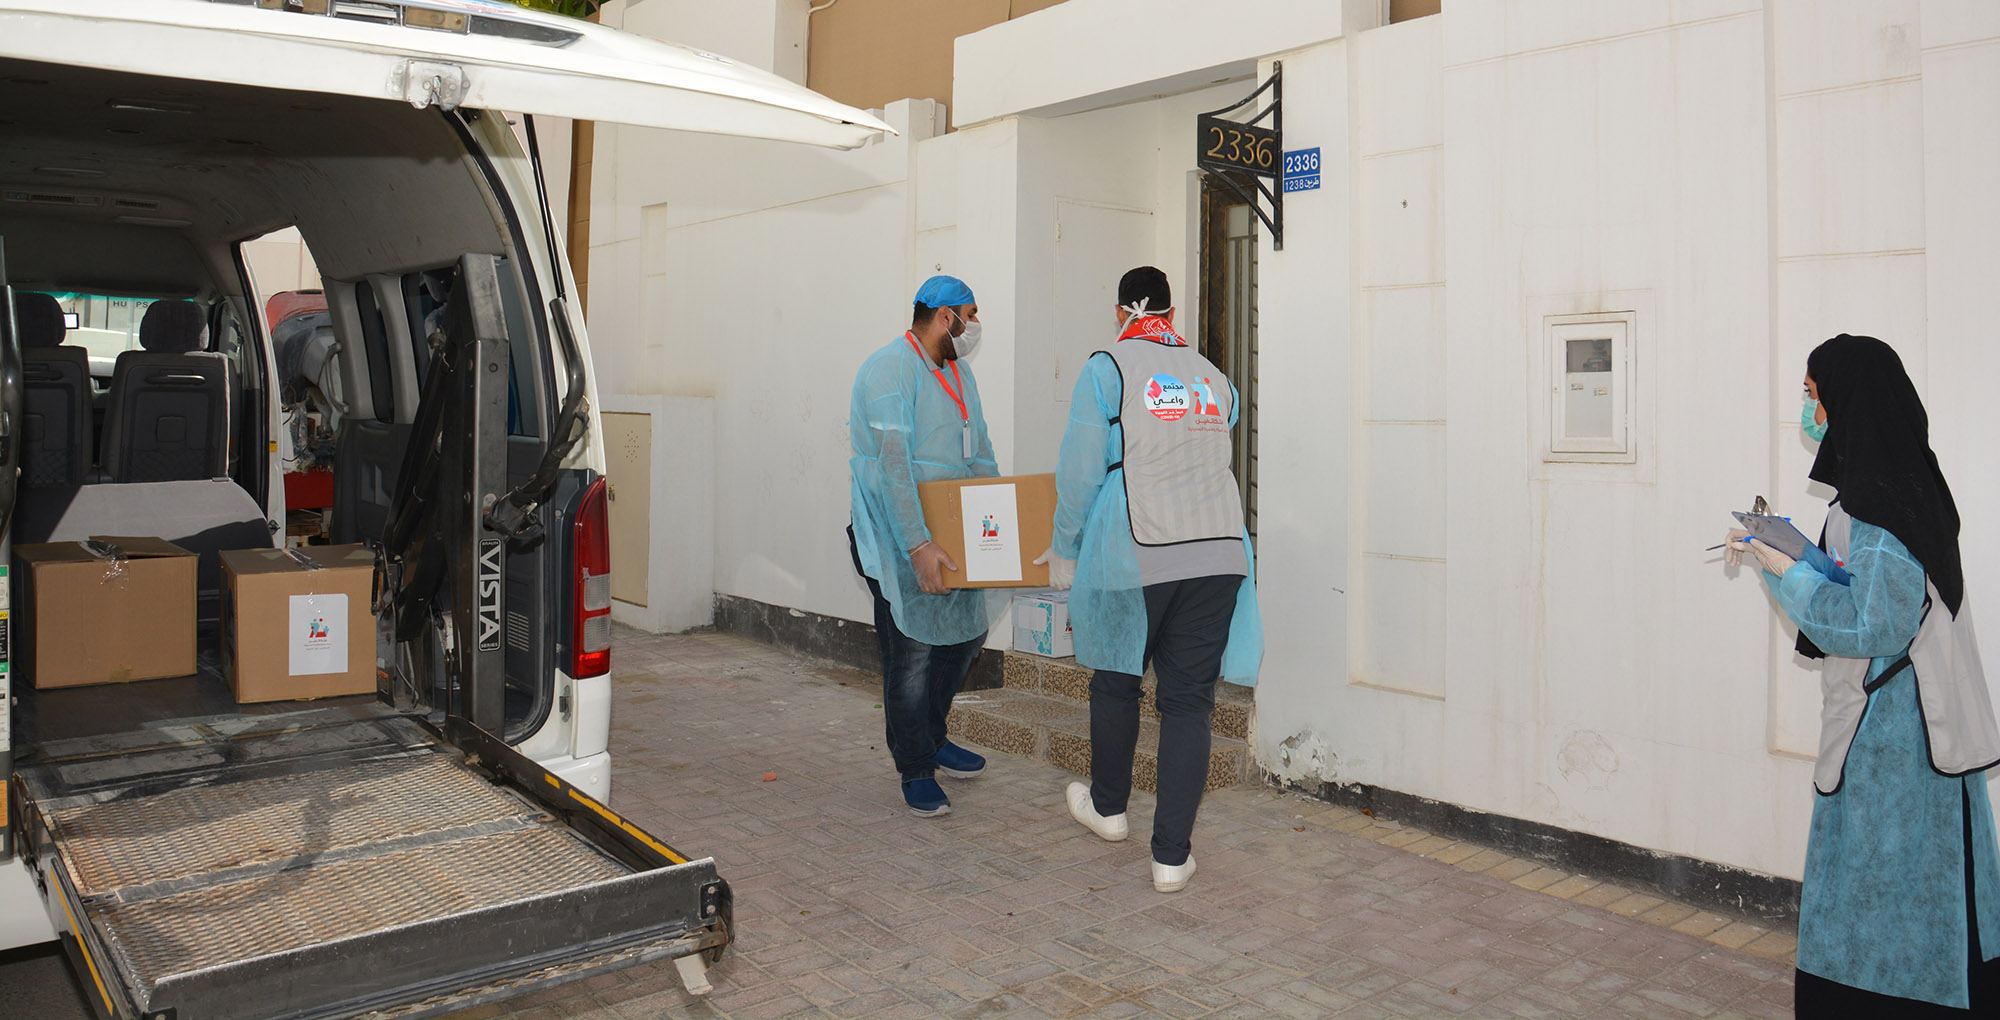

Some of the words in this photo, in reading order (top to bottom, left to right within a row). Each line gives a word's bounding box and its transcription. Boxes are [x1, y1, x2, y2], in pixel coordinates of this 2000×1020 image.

[1207, 127, 1274, 167] 2336
[1286, 153, 1319, 173] 2336
[1285, 180, 1304, 191] 1238
[1162, 383, 1184, 392] مجتمع
[1153, 396, 1184, 408] واعي
[480, 545, 500, 643] VISTA
